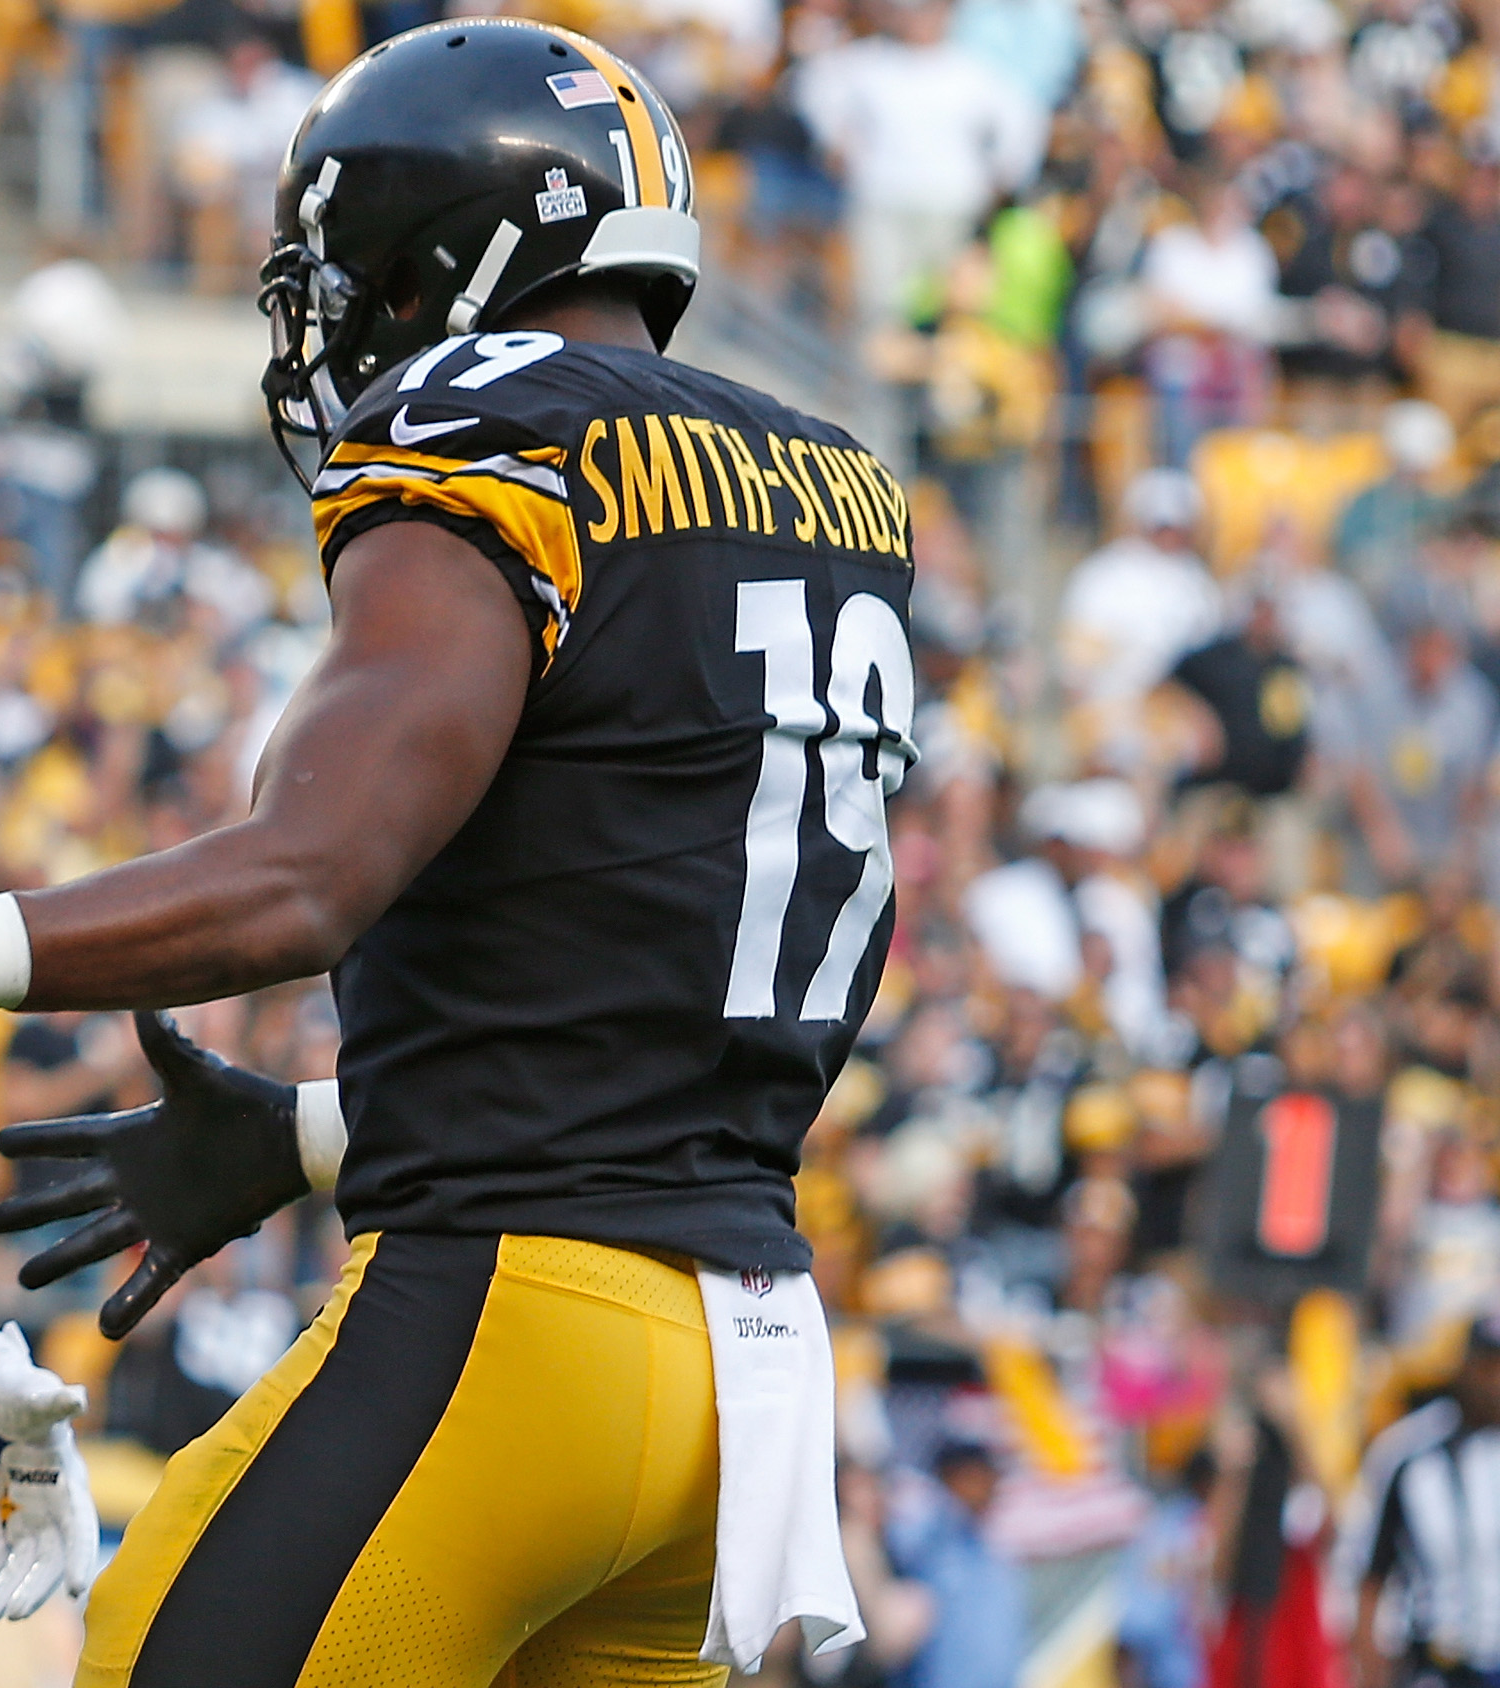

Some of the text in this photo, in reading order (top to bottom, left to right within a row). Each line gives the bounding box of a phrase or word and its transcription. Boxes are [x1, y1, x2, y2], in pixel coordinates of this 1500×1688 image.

[539, 190, 579, 203] CRUCIAL
[608, 129, 687, 212] 19
[541, 199, 583, 216] CATCH
[397, 330, 565, 391] 19
[723, 578, 921, 1022] 19
[1257, 1091, 1338, 1255] 1
[732, 1316, 790, 1338] Wilson
